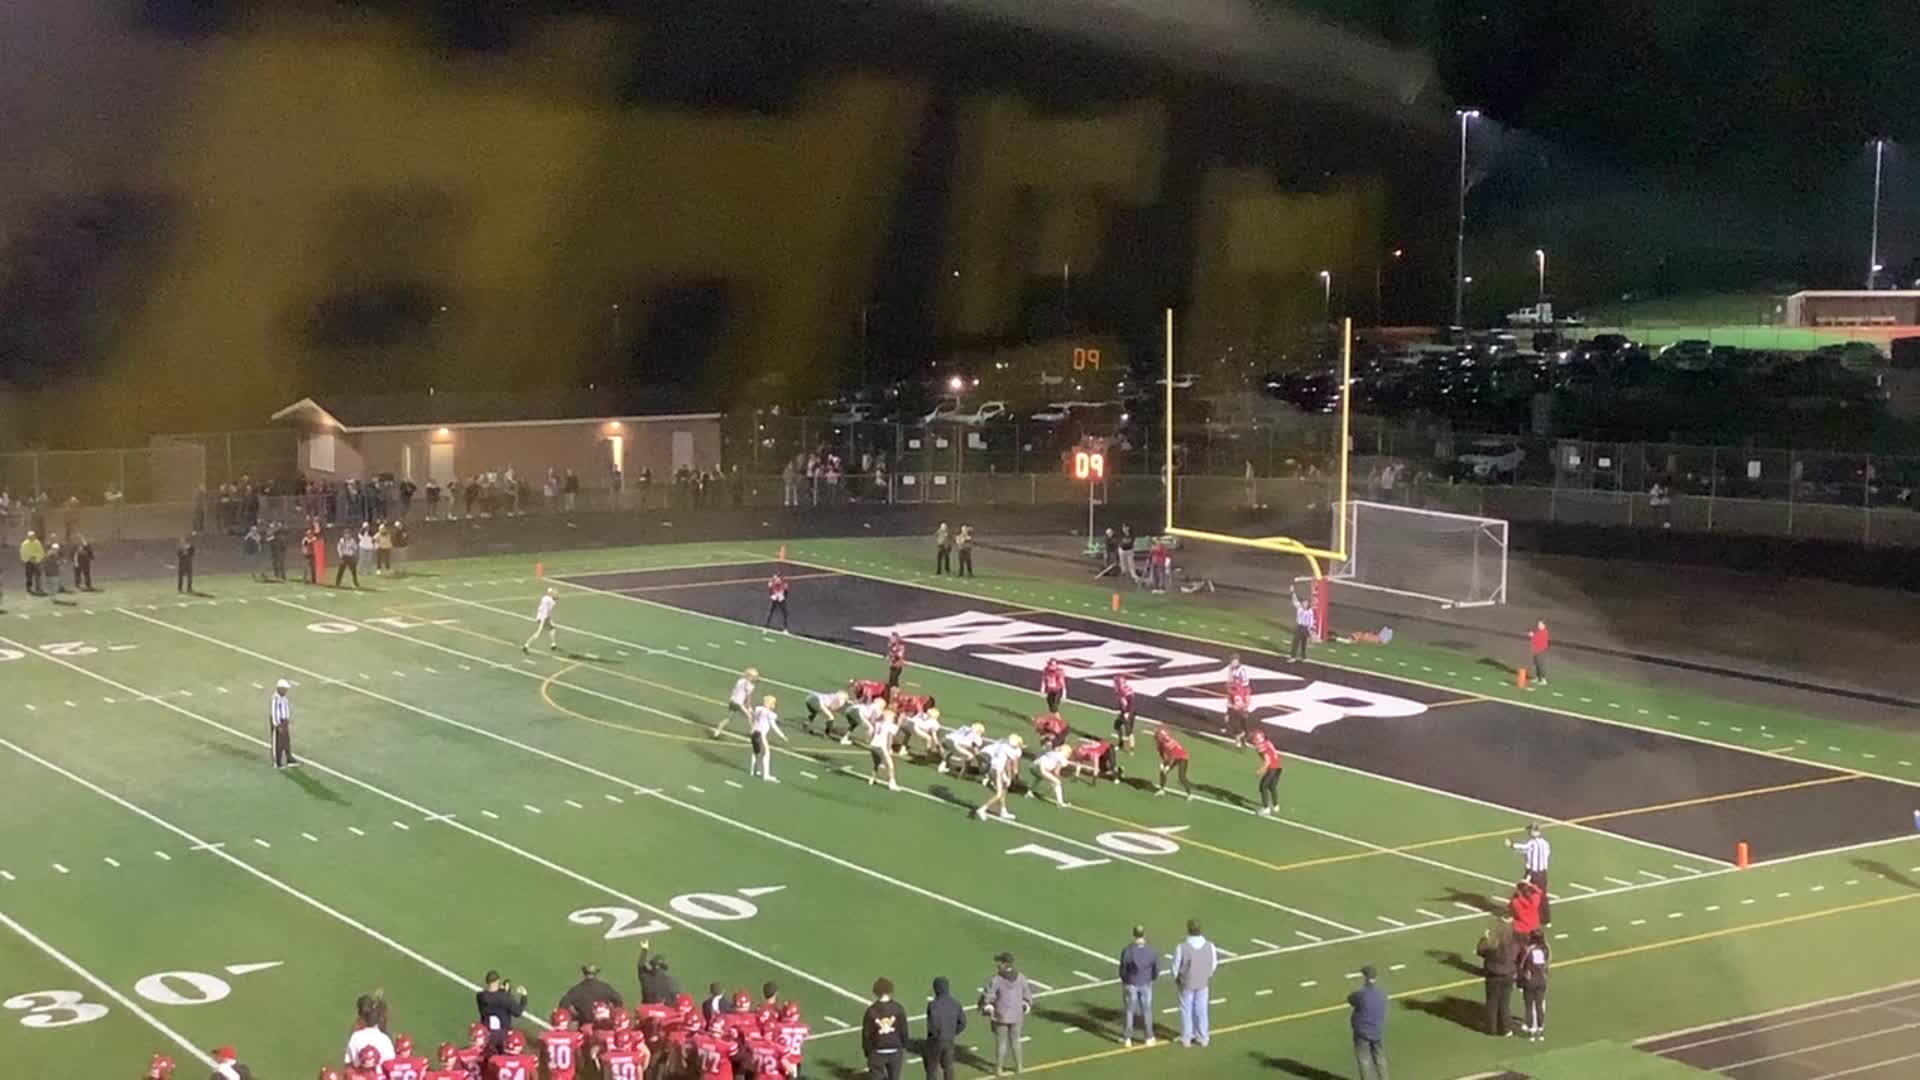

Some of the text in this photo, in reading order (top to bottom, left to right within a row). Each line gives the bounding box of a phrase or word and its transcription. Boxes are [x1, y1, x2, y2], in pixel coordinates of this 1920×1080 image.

[1075, 452, 1104, 478] 09
[1004, 831, 1181, 870] 10
[567, 892, 758, 940] 20
[2, 970, 232, 1028] 30
